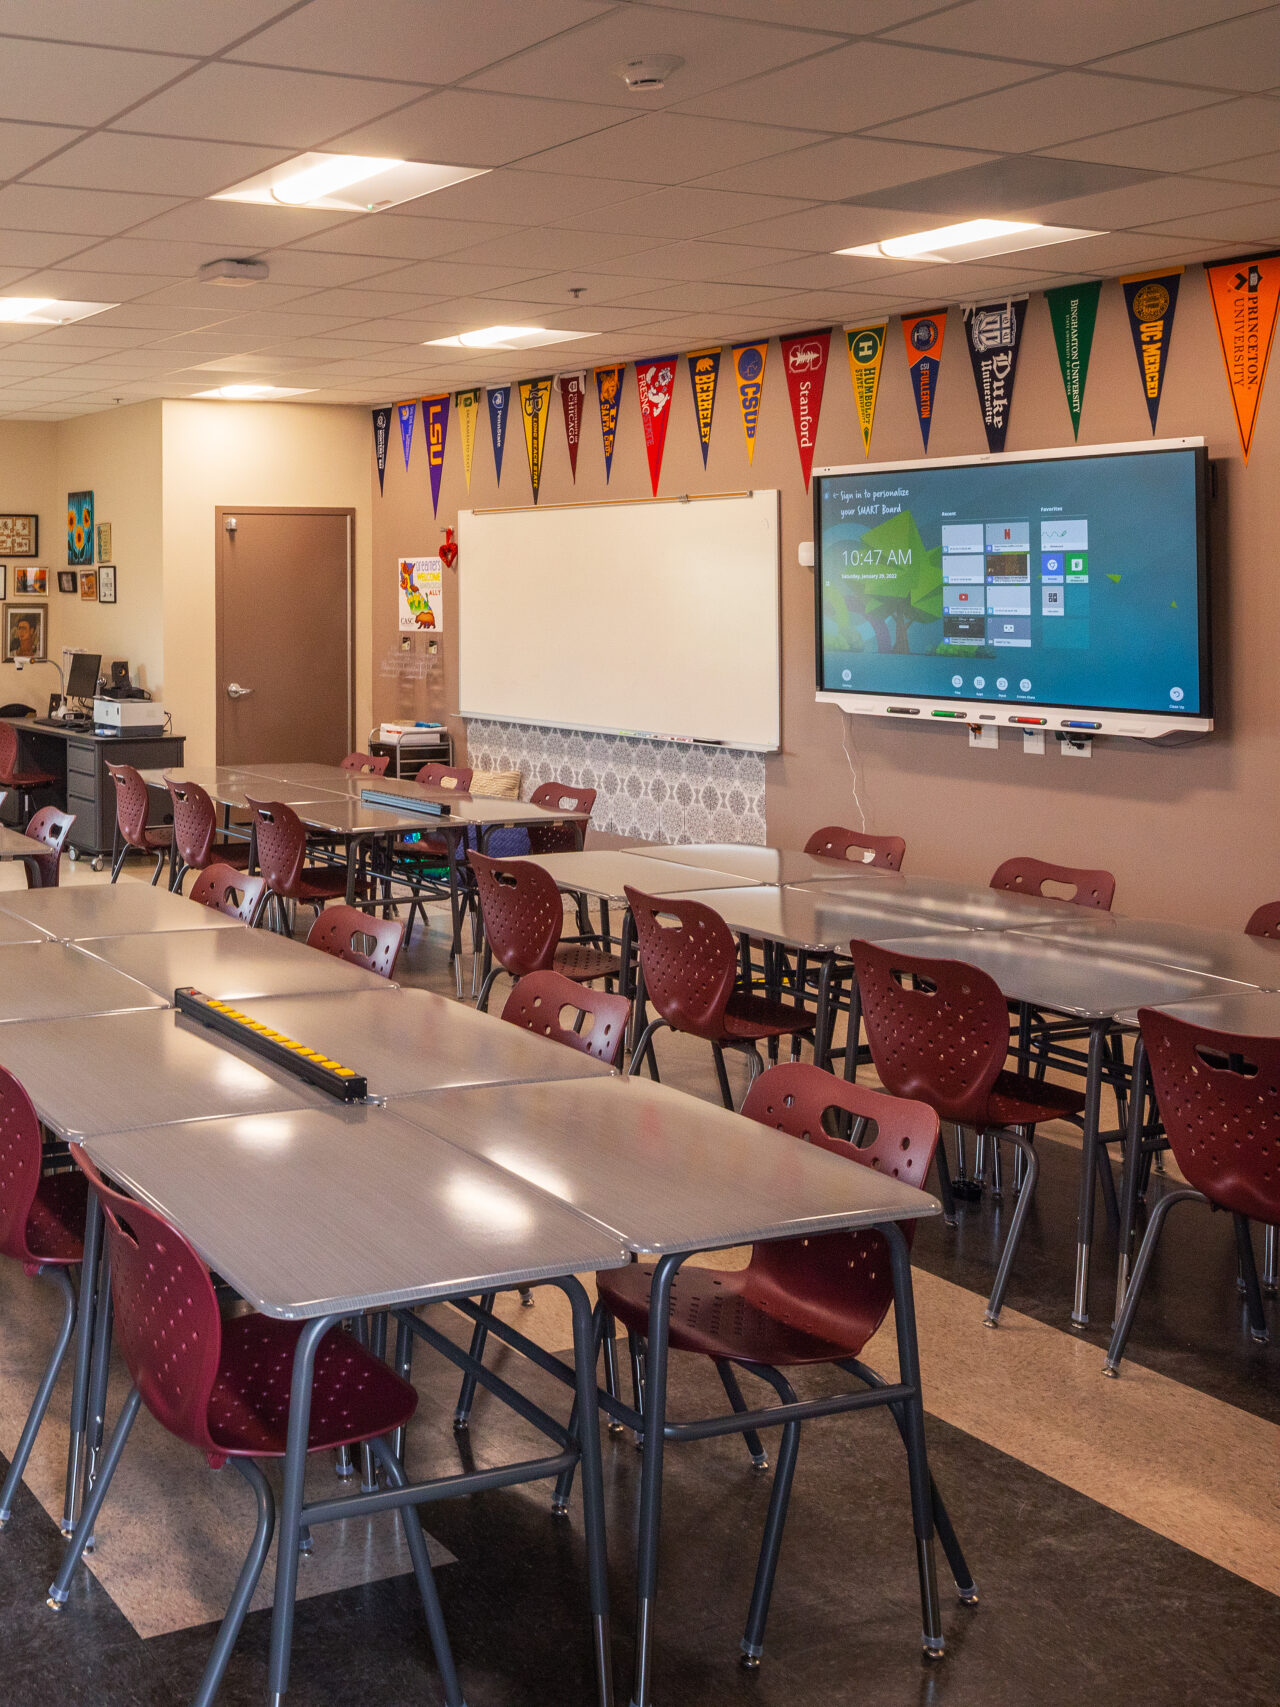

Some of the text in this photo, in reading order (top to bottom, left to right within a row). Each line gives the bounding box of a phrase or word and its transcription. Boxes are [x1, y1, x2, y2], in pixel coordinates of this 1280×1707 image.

[1070, 299, 1080, 413] BINGHAMTON UNIVERSITY
[1139, 320, 1164, 398] UC MERCED
[1233, 297, 1244, 388] UNIVERSITY
[1247, 296, 1258, 386] PRINCETON
[638, 373, 655, 446] FRESNO STATE
[695, 372, 716, 444] BERKELEY
[855, 368, 863, 390] STATE
[863, 367, 876, 425] HUMBOLDT
[920, 370, 931, 418] FULLERTON
[992, 350, 1013, 429] Duke
[429, 405, 443, 466] LSU
[601, 403, 610, 432] SANTA
[740, 382, 761, 439] CSUB
[800, 381, 813, 448] Stanford
[840, 487, 910, 503] Sign in to personalize
[840, 503, 902, 519] your SMART Board
[841, 549, 912, 566] 10:47 AM
